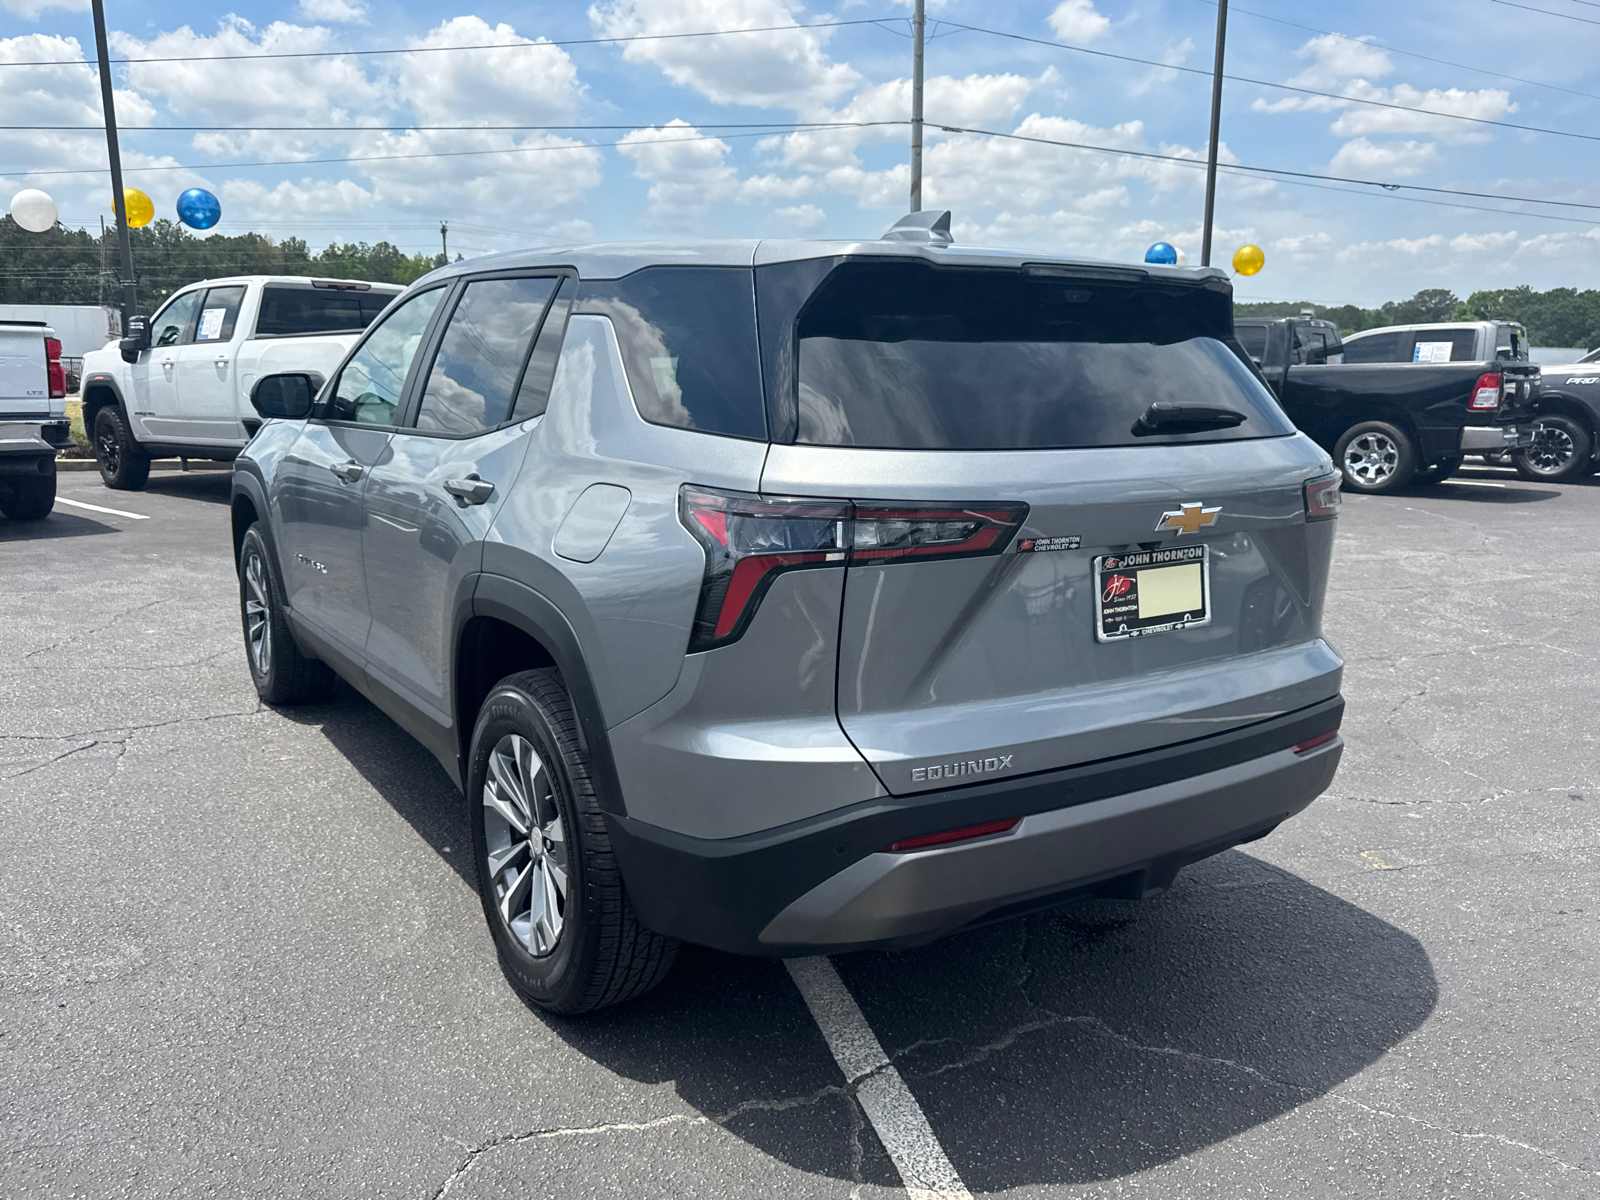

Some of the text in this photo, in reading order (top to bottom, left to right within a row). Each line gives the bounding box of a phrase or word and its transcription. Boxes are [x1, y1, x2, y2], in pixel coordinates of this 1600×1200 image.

[1565, 377, 1600, 385] PRO
[1035, 536, 1080, 546] JOHN THORNTON
[1034, 543, 1069, 552] CHEVROLET
[1122, 547, 1203, 567] JOHN THORNTON
[1114, 605, 1138, 613] THORNTON
[1141, 624, 1174, 636] CHEVROLET
[911, 754, 1014, 782] EQUINOX
